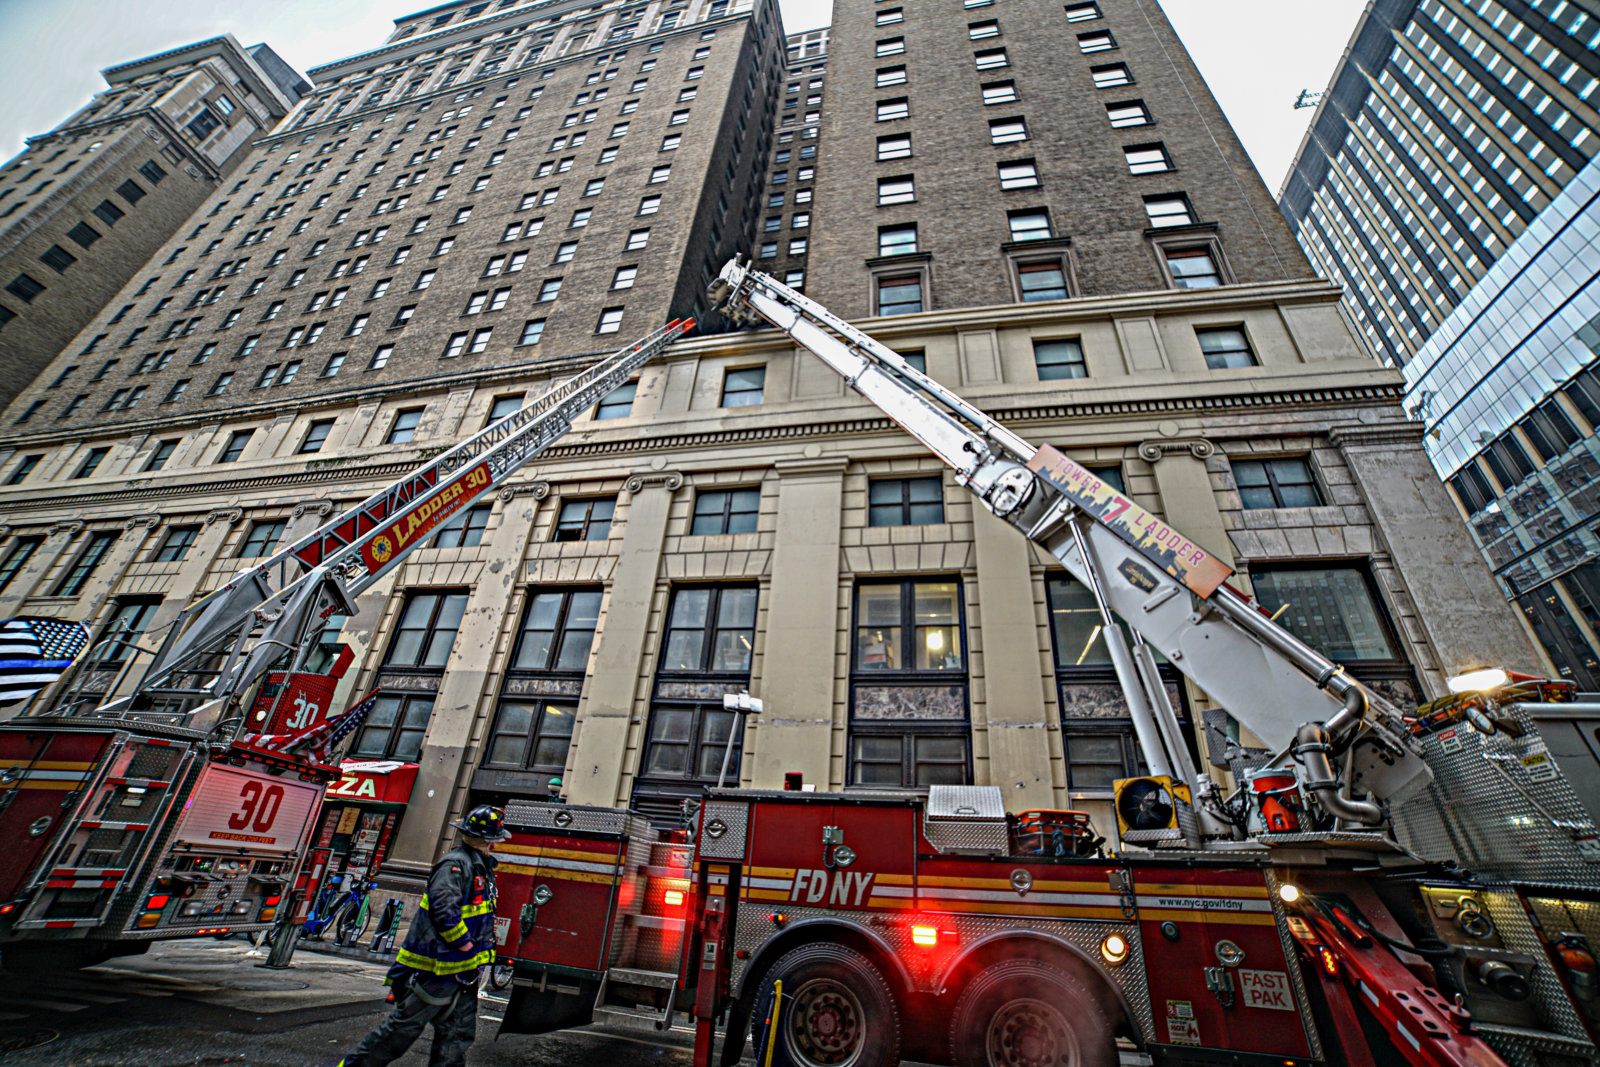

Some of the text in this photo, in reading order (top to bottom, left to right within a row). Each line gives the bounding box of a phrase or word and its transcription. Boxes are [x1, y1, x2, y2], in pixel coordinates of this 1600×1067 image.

[1054, 456, 1102, 495] TOWER
[392, 466, 487, 548] LADDER 30
[1101, 495, 1133, 524] 7
[1134, 512, 1207, 568] LADDER
[320, 605, 337, 620] 100
[286, 698, 319, 730] 30
[228, 780, 285, 833] 30
[212, 832, 230, 840] KEEP
[791, 868, 874, 906] FDNY
[1158, 898, 1243, 911] www.nyc.gov/fdny
[1241, 972, 1285, 989] FAST
[1251, 990, 1288, 1008] PAK
